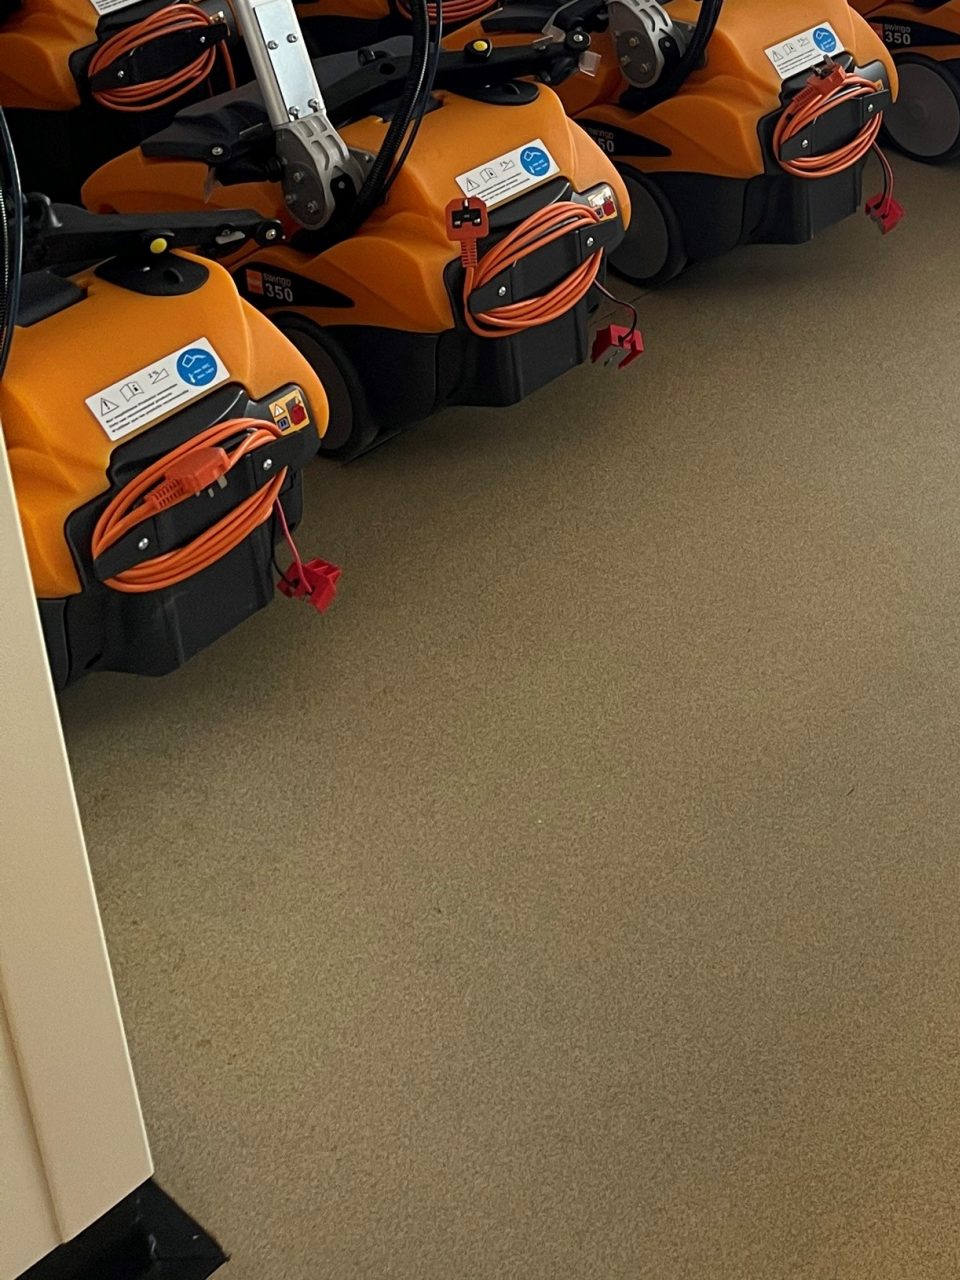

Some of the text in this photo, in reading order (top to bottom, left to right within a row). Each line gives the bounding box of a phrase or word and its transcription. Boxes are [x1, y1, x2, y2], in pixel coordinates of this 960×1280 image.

[885, 31, 911, 45] 350
[597, 138, 615, 153] 50
[265, 282, 294, 302] 350
